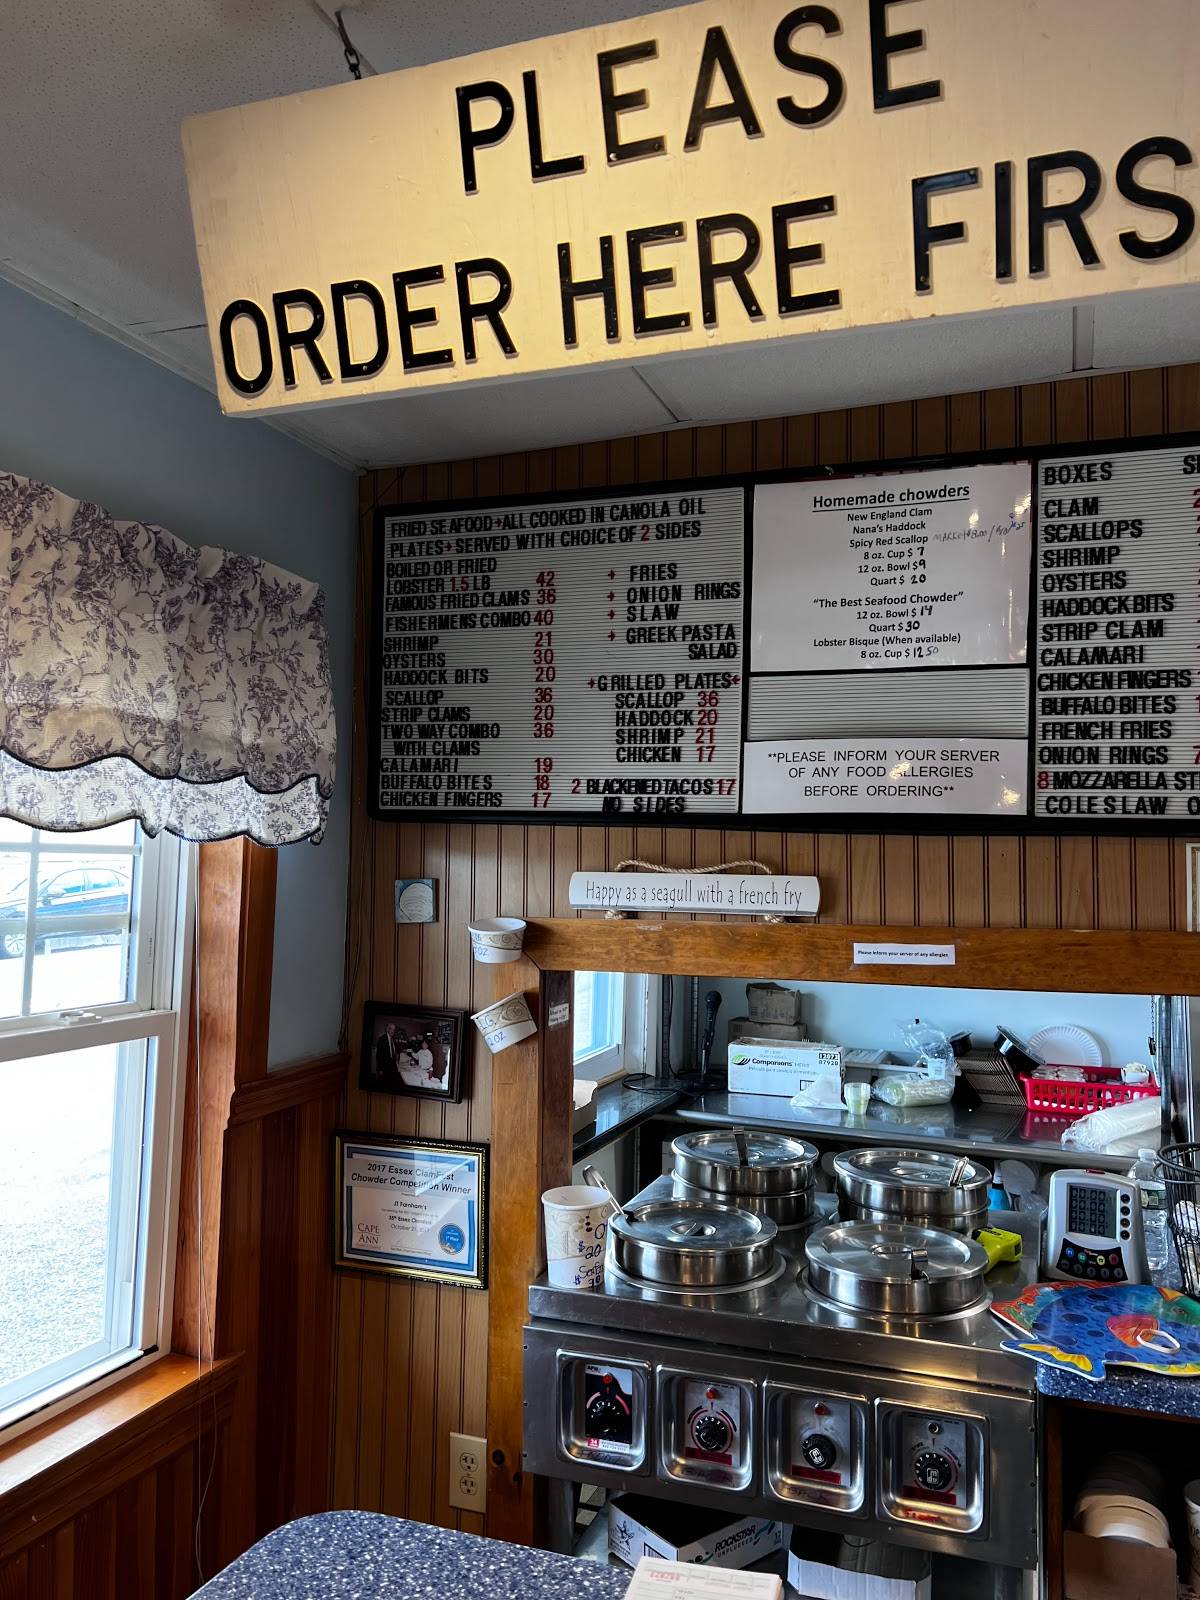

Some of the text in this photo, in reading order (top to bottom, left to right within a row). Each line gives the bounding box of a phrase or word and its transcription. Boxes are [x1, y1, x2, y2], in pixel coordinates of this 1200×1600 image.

[456, 0, 943, 195] PLEASE
[219, 257, 519, 397] ORDER
[557, 195, 842, 349] HERE
[1043, 461, 1113, 485] BOXES
[813, 484, 970, 509] Homemade chowders
[847, 507, 933, 523] New England Clam
[1043, 496, 1099, 519] CLAM
[391, 521, 427, 538] FRIED
[529, 508, 586, 530] COOKED
[590, 506, 605, 524] IN
[609, 500, 671, 522] CANOLA
[678, 497, 706, 515] OIL
[516, 532, 555, 550] WITH
[560, 526, 616, 547] CHOICE
[619, 525, 637, 543] OF
[640, 524, 650, 542] 2
[655, 520, 702, 540] SIDES
[853, 524, 883, 535] Nana's
[885, 521, 926, 533] Haddock
[1043, 519, 1143, 544] SCALLOPS
[849, 533, 929, 549] Spicy Red Scallop
[1042, 545, 1121, 569] SHRIMP
[386, 557, 497, 578] BOILED OR FRIED
[629, 562, 678, 582] FRIES
[386, 578, 445, 596] LOBSTER
[473, 574, 491, 591] LB
[535, 571, 556, 588] 42
[1042, 570, 1127, 593] OYSTERS
[385, 589, 531, 613] FAMOUS FRIED CLAMS
[536, 588, 557, 605] 36
[626, 582, 741, 604] ONION RINGS
[840, 596, 862, 608] Best
[864, 595, 907, 607] Seafood
[626, 603, 679, 623] SLAW
[1042, 592, 1175, 618] HADDOCK BITS
[385, 610, 531, 632] FISHERMENS COMBO
[534, 609, 554, 627] 40
[535, 631, 553, 647] 21
[626, 623, 735, 645] GREEK PASTA
[1041, 618, 1164, 643] STRIP CLAM
[383, 635, 439, 652] SHRIMP
[813, 632, 962, 649] Lobster Bisque (When available)
[533, 649, 554, 666] 30
[687, 642, 738, 660] SALAD
[1040, 645, 1144, 667] CALAMARI
[382, 652, 446, 670] OYSTERS
[384, 668, 489, 686] HADDOCK BITS
[535, 665, 556, 682] 20
[597, 672, 732, 692] GRILLED PLATES
[1037, 669, 1192, 692] CHICKEN FINGERS
[386, 690, 444, 706] SCALLOP
[534, 687, 553, 704] 36
[615, 690, 719, 709] SCALLOP 36
[380, 706, 471, 723] STRIP CLAMS
[534, 705, 554, 721] 20
[1041, 695, 1177, 716] BUFFALO BITES
[615, 709, 718, 727] HADDOCK 20
[381, 722, 501, 740] TWO WAY COMBO
[533, 722, 554, 739] 36
[615, 727, 716, 745] SHRIMP 21
[1041, 720, 1173, 740] FRENCH FRIES
[393, 740, 481, 757] WITH CLAMS
[616, 745, 717, 763] CHICKEN 17
[833, 750, 887, 762] INFORM
[895, 750, 936, 762] YOUR
[940, 750, 1000, 762] SERVER
[1039, 745, 1169, 765] ONION RINGS
[380, 757, 459, 773] CALAMARI
[534, 757, 553, 774] 19
[788, 767, 805, 778] OF
[812, 767, 840, 778] ANY
[847, 766, 887, 778] FOOD
[380, 774, 493, 791] BUFFALO BITES
[533, 775, 550, 791] 18
[1037, 770, 1168, 790] 8 MOZZARELLA
[380, 791, 503, 808] CHICKEN FINGERS
[531, 792, 552, 808] 17
[804, 785, 858, 797] BEFORE
[602, 796, 687, 813] NO SIDES
[586, 880, 802, 911] Happy as a seagull with a french fry
[751, 1058, 793, 1067] Companions
[367, 1163, 413, 1176] 2017 Essex
[351, 1172, 471, 1195] Chowder Winner
[357, 1222, 380, 1233] CAPE
[358, 1233, 379, 1244] ANN
[714, 1524, 757, 1553] ROCKSTAR
